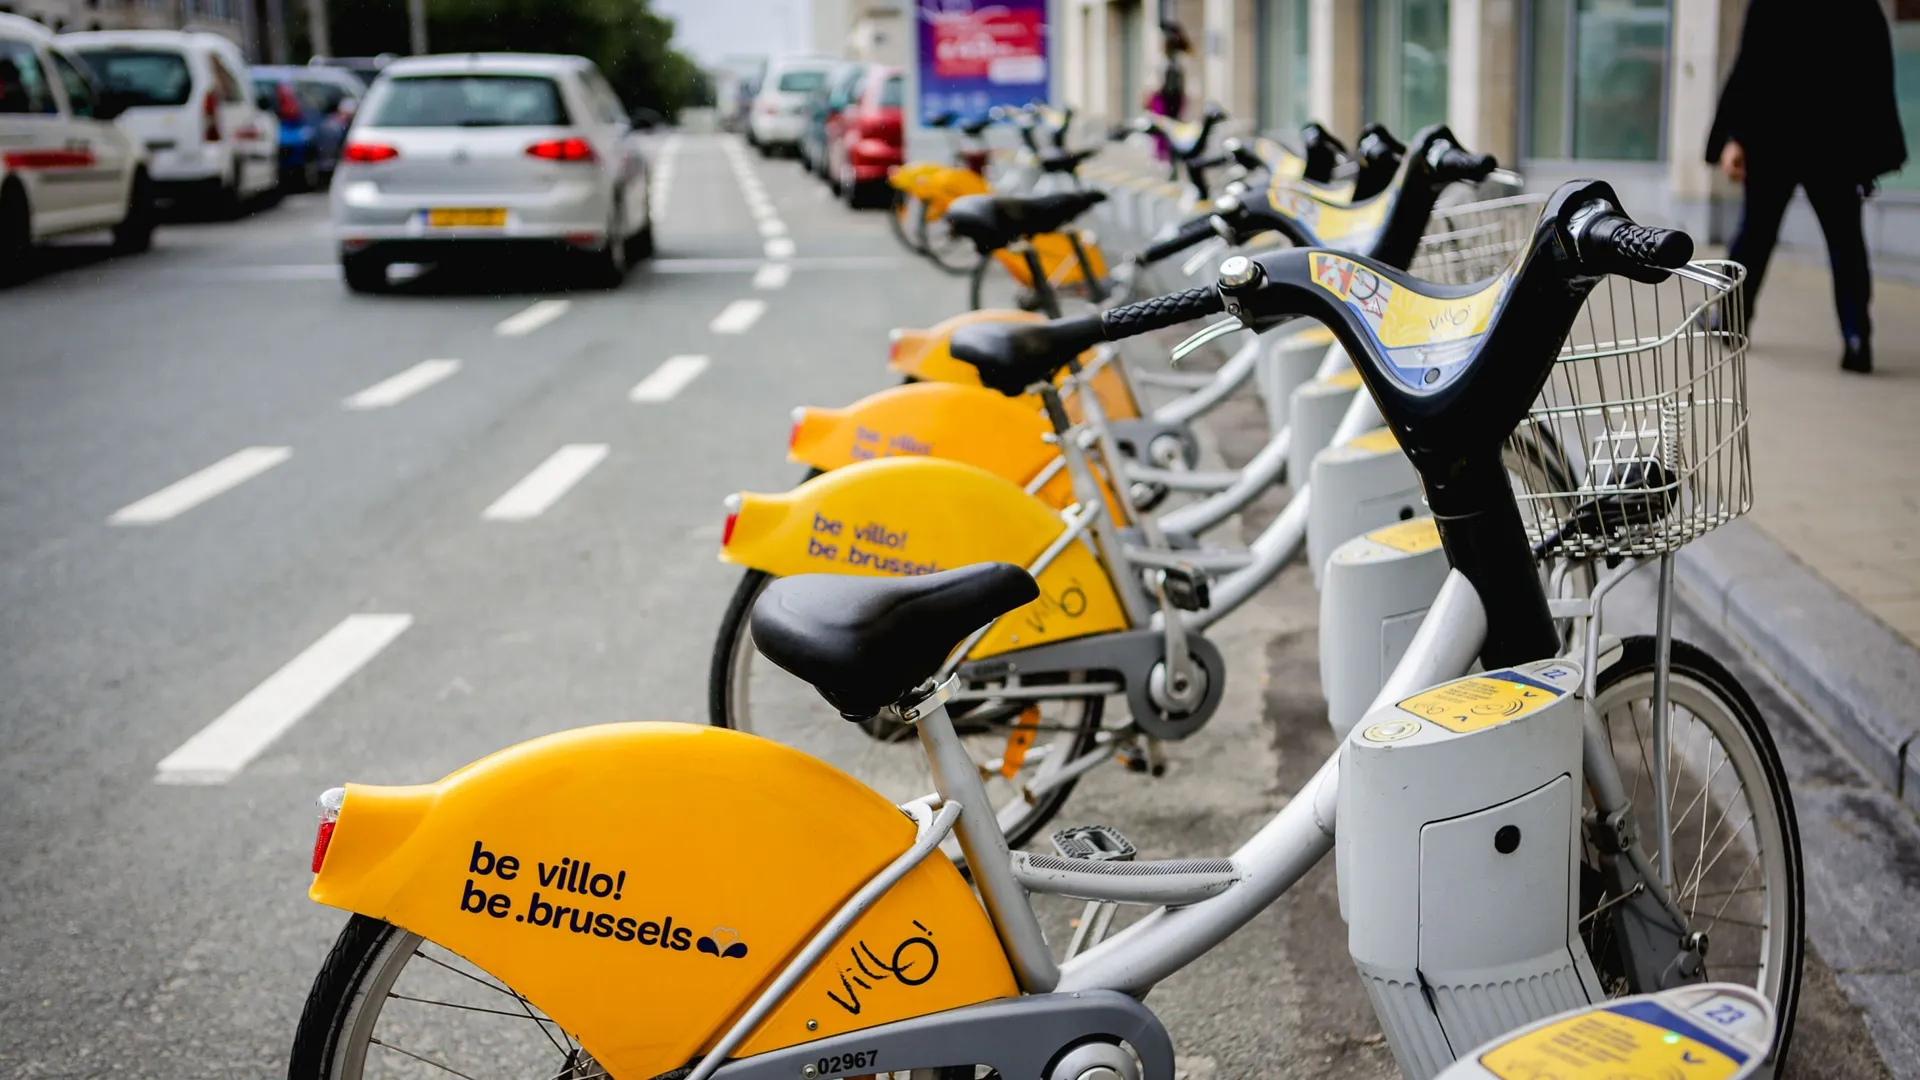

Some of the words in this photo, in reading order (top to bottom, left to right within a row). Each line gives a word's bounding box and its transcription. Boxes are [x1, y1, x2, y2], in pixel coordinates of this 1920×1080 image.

[813, 512, 843, 536] be
[854, 521, 908, 550] villo!
[1542, 669, 1568, 680] 22
[469, 841, 520, 881] be
[537, 857, 627, 900] villo!
[1705, 1004, 1746, 1025] 23
[818, 1050, 878, 1075] 02967
